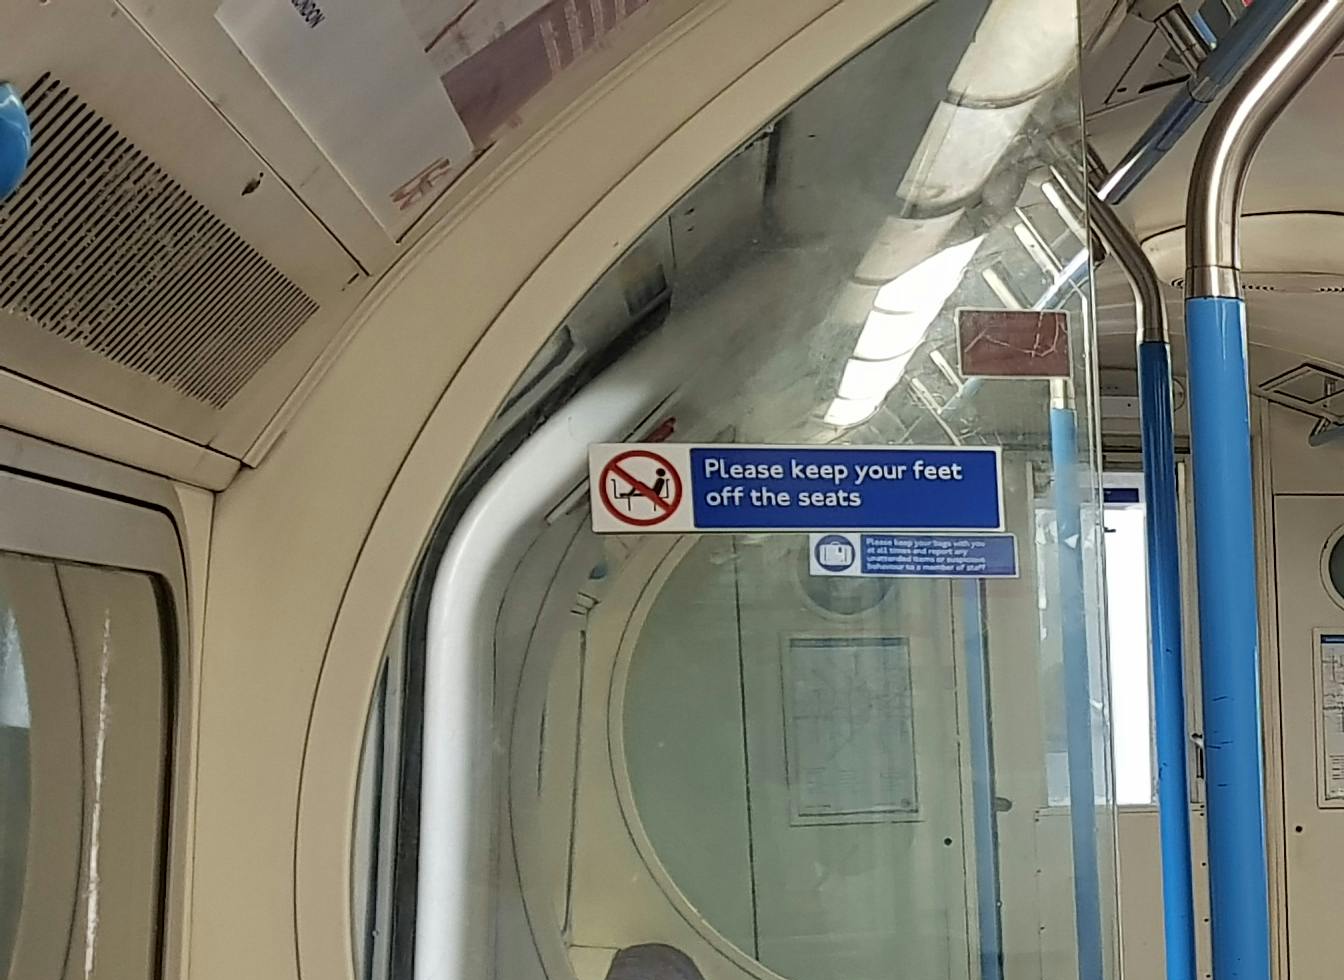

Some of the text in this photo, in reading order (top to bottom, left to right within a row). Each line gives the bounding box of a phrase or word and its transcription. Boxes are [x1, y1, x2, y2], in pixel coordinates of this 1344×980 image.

[703, 458, 963, 485] Please keep your feet
[706, 487, 861, 507] off the seats
